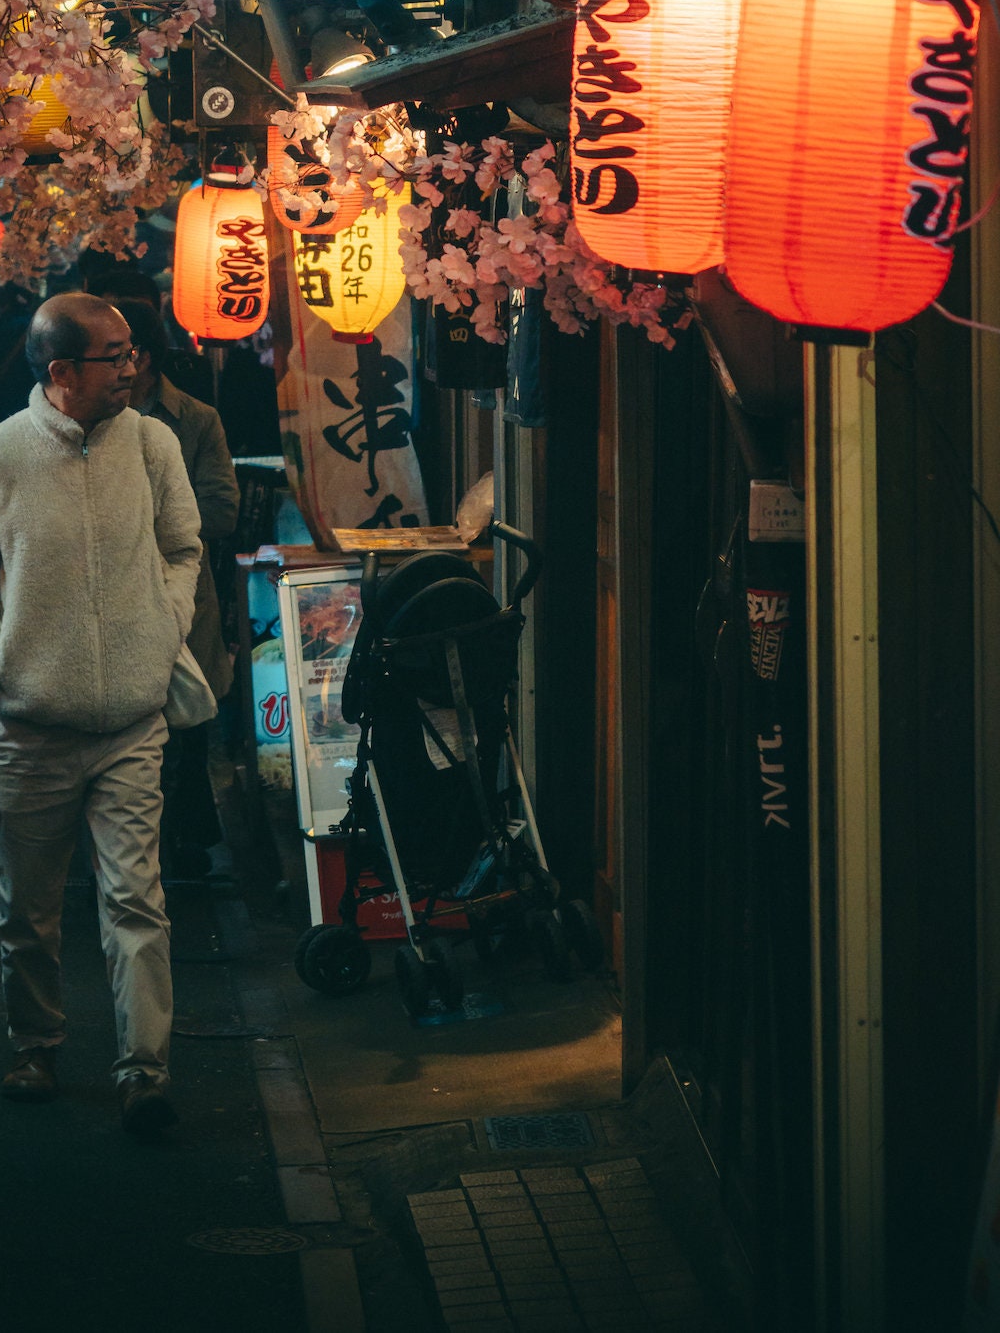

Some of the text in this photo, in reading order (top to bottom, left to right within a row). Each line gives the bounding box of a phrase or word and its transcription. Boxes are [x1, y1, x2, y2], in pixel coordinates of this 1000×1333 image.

[218, 217, 267, 322] やきとり
[341, 211, 373, 305] 和26年
